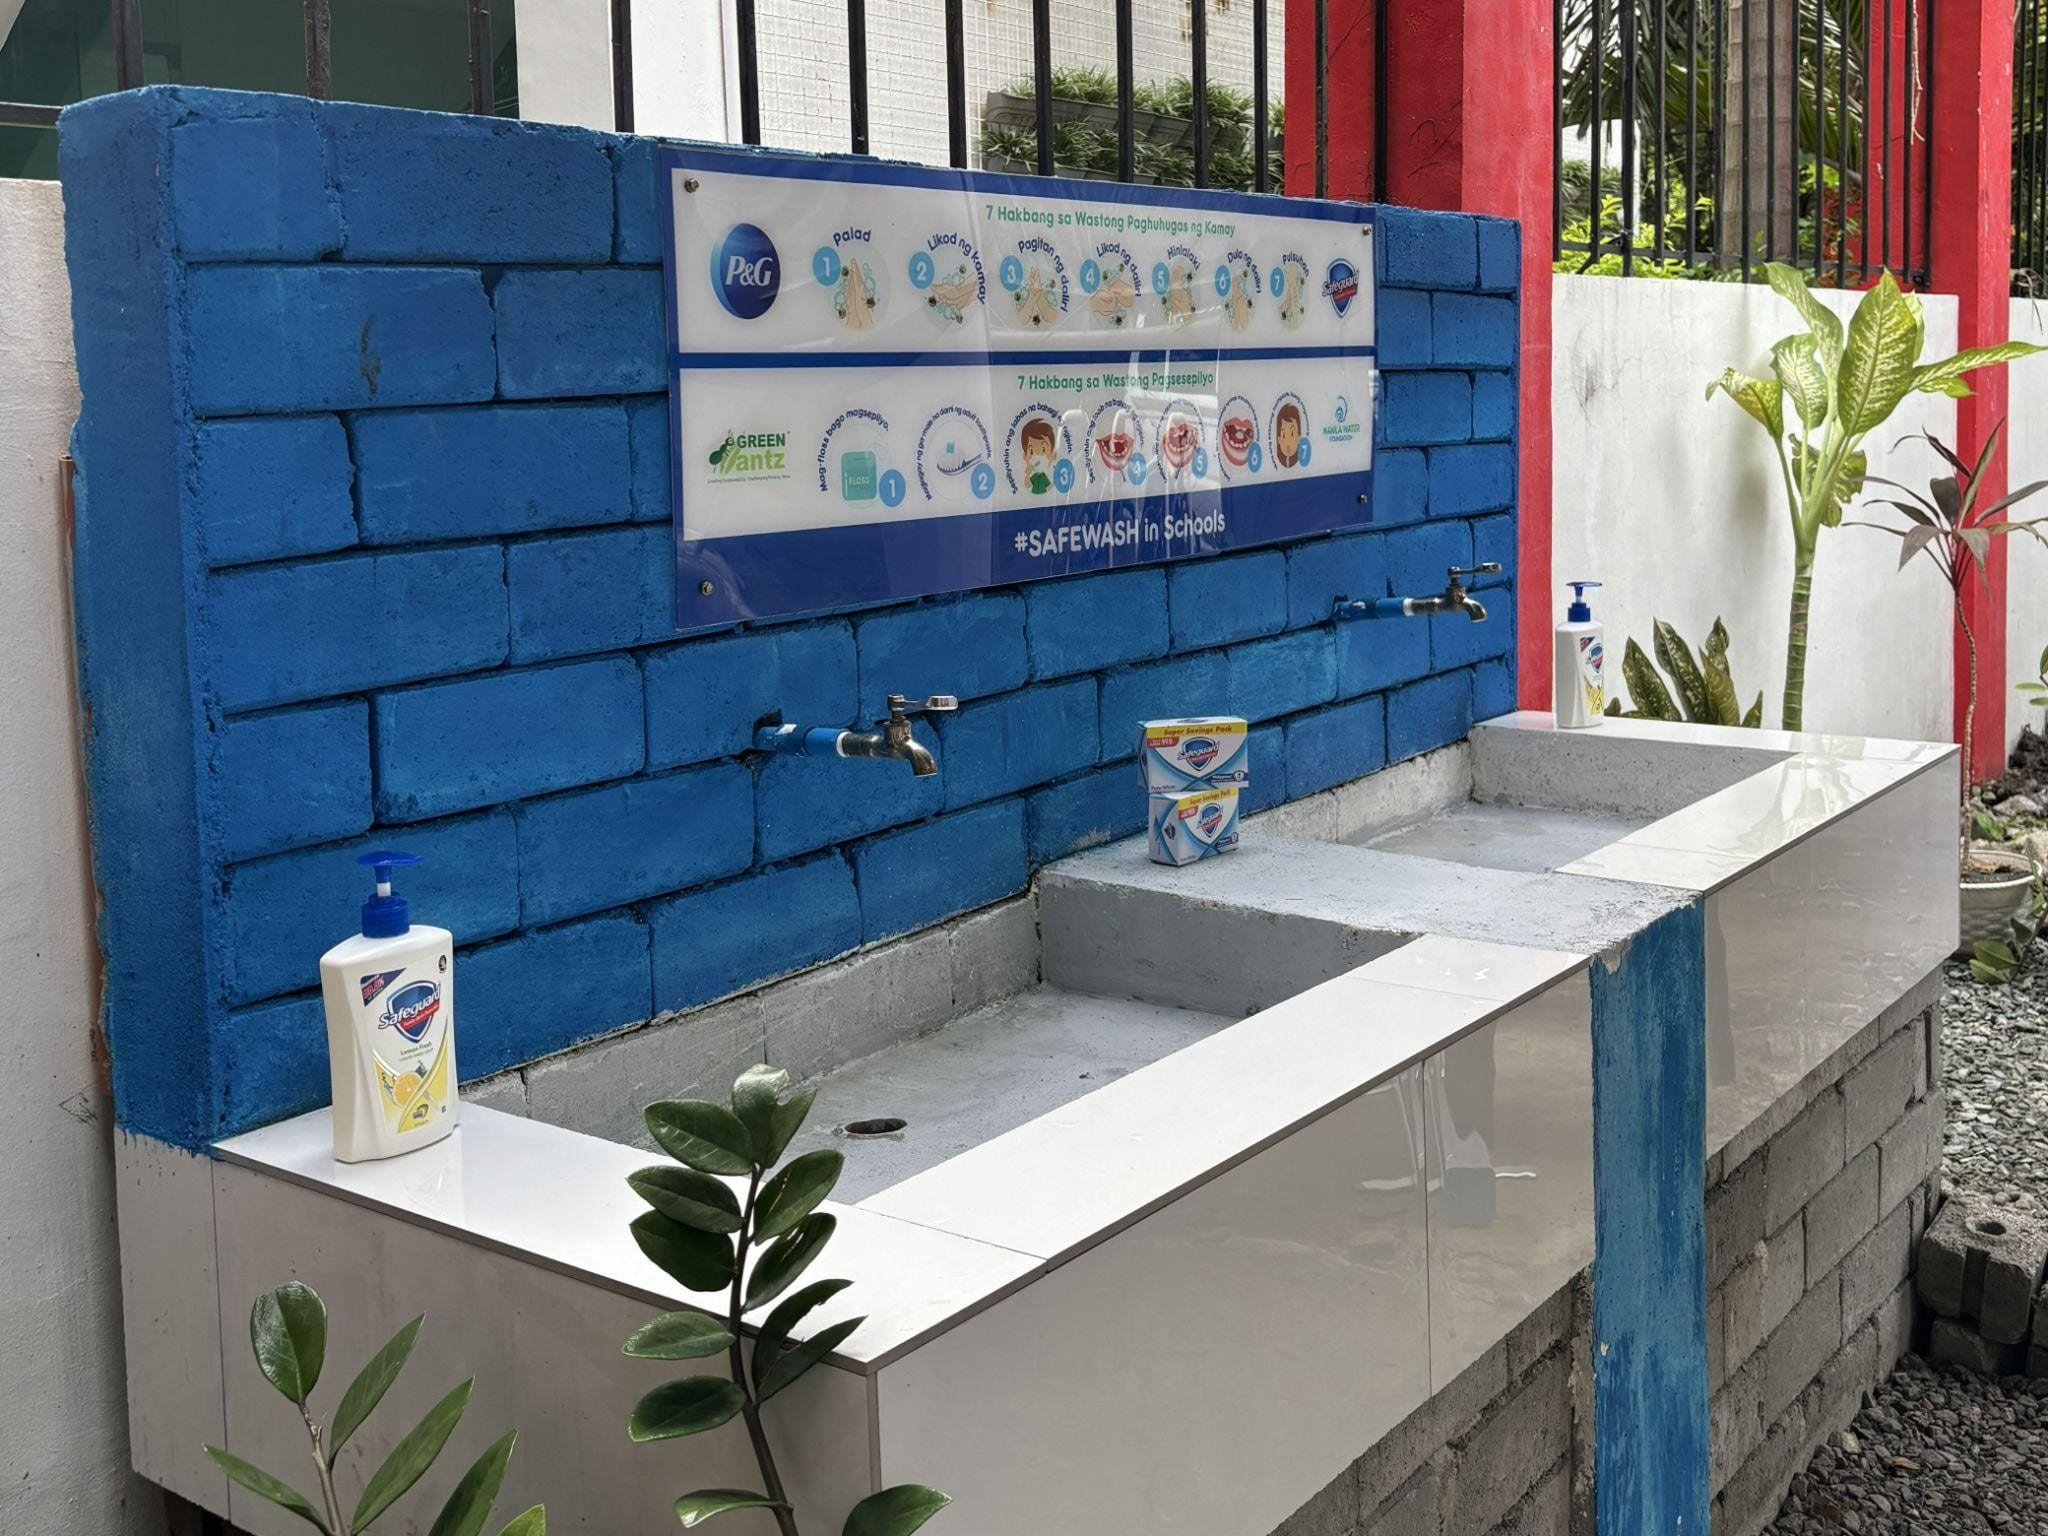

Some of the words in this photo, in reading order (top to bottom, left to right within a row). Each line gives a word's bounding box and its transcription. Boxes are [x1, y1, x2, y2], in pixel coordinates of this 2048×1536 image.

[986, 205, 994, 219] 7
[998, 206, 1054, 228] Hakbang
[1058, 213, 1072, 225] sa
[1075, 211, 1124, 232] Wastong
[1127, 215, 1188, 235] Paghuhugas
[1191, 222, 1202, 237] ng
[1205, 221, 1236, 237] Kamay
[823, 256, 830, 278] 1
[1167, 244, 1201, 271] Hinlalaki
[1243, 253, 1253, 268] ng
[725, 255, 774, 287] P&G
[916, 262, 927, 281] 2
[928, 233, 957, 251] Likod
[958, 238, 972, 257] ng
[970, 250, 987, 305] kamay
[1007, 264, 1017, 284] 3
[1085, 267, 1095, 287] 4
[1096, 242, 1121, 258] Likod
[1120, 248, 1132, 266] ng
[1129, 263, 1142, 297] daliri
[1053, 255, 1065, 274] ng
[1060, 274, 1070, 312] daliri
[1156, 270, 1165, 289] 5
[1219, 273, 1227, 290] 6
[1274, 275, 1281, 291] 7
[1321, 268, 1360, 298] Safeguard
[1017, 375, 1026, 390] 7
[1029, 373, 1083, 393] Hakbang
[1086, 376, 1100, 388] sa
[1102, 372, 1149, 391] Wastong
[1151, 371, 1214, 390] Pagsesepilyo
[736, 433, 786, 449] GREEN
[1005, 429, 1016, 447] ang
[816, 437, 829, 492] Mag-floss
[825, 414, 845, 437] bago
[845, 408, 889, 432] magsepilyo.
[1301, 444, 1308, 460] 7
[978, 472, 988, 491] 2
[1059, 467, 1068, 485] 3
[889, 479, 897, 499] 1
[1015, 518, 1139, 557] #SAFEWASH
[1144, 518, 1159, 542] in
[1163, 509, 1226, 540] Schools
[1164, 728, 1184, 736] Super
[1186, 726, 1214, 736] Savings
[1215, 725, 1233, 733] Pack
[377, 981, 442, 1030] Safeguard
